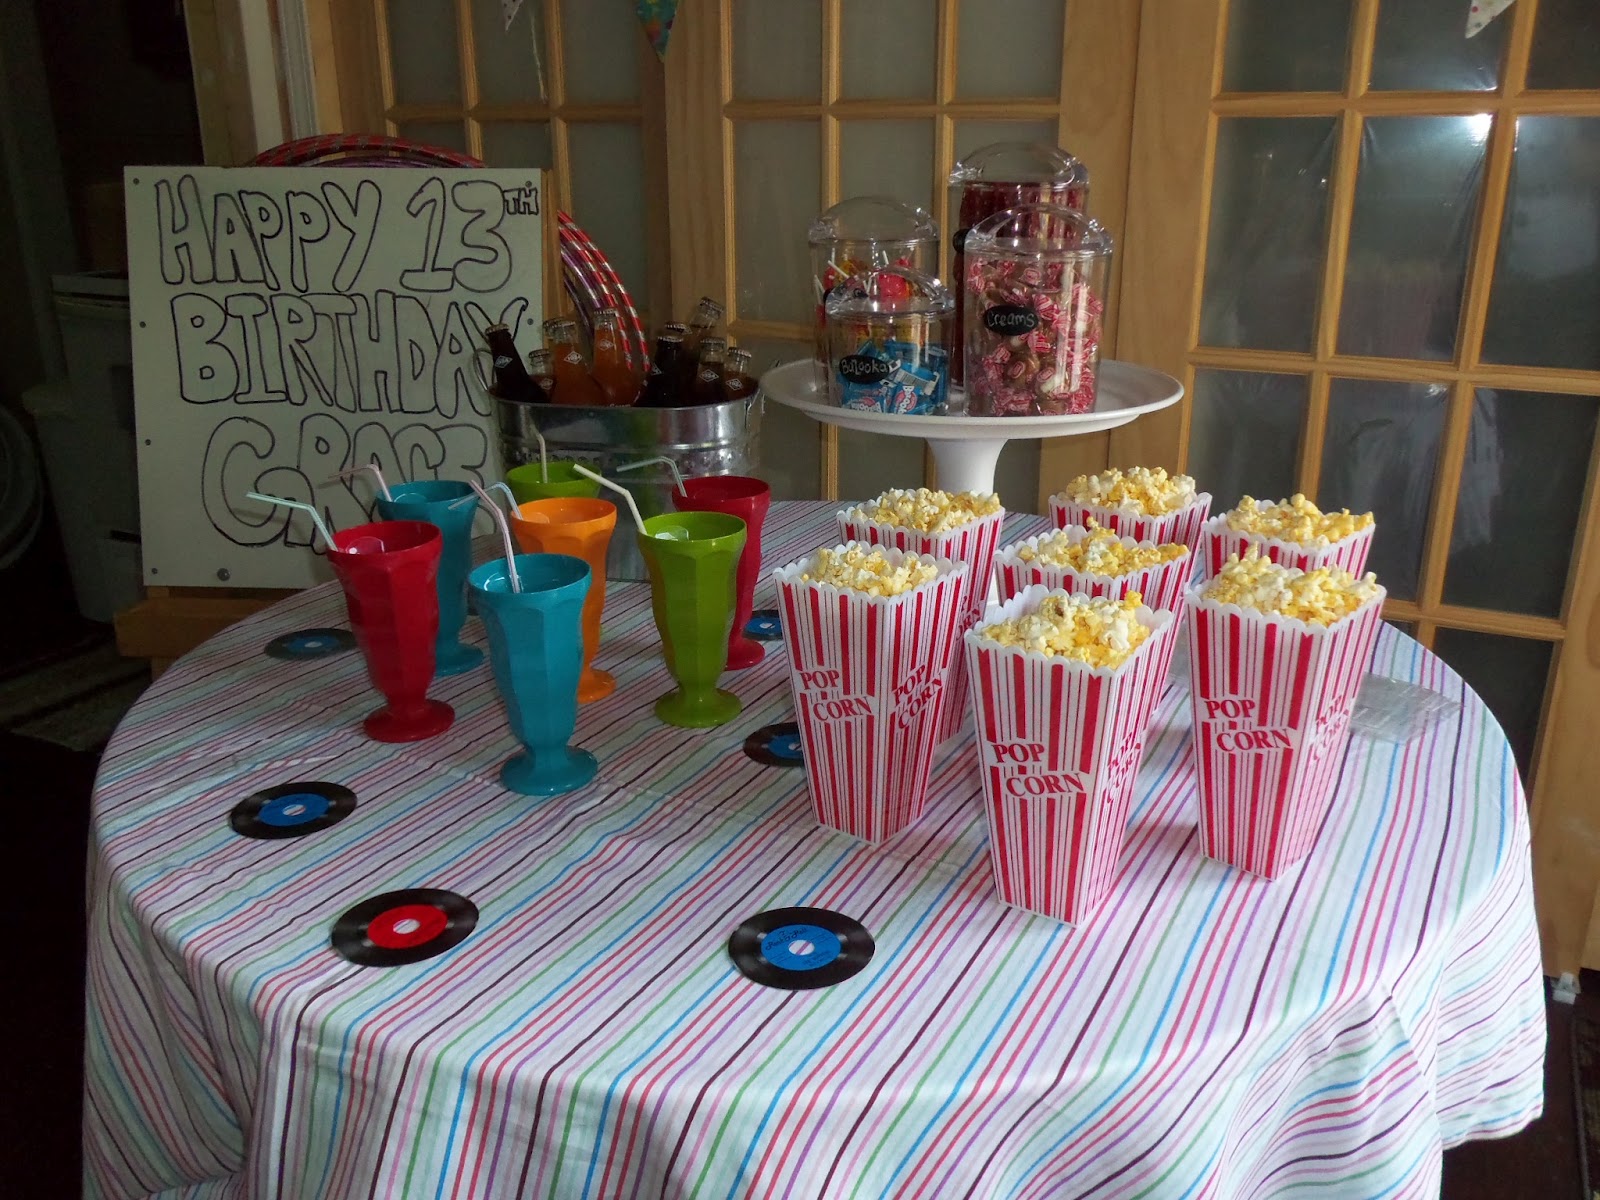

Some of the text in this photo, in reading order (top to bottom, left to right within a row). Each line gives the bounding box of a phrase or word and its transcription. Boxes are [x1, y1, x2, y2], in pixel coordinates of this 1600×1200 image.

[154, 174, 382, 292] HAPPY
[988, 312, 1035, 327] Creams
[170, 289, 529, 419] BIRTHDAY
[800, 669, 840, 690] POP
[893, 665, 925, 706] POP
[813, 696, 872, 722] CORN
[899, 671, 943, 729] CORN
[1204, 699, 1256, 719] POP
[1216, 728, 1293, 752] CORN
[991, 743, 1045, 763] POP
[1006, 772, 1084, 797] CORN
